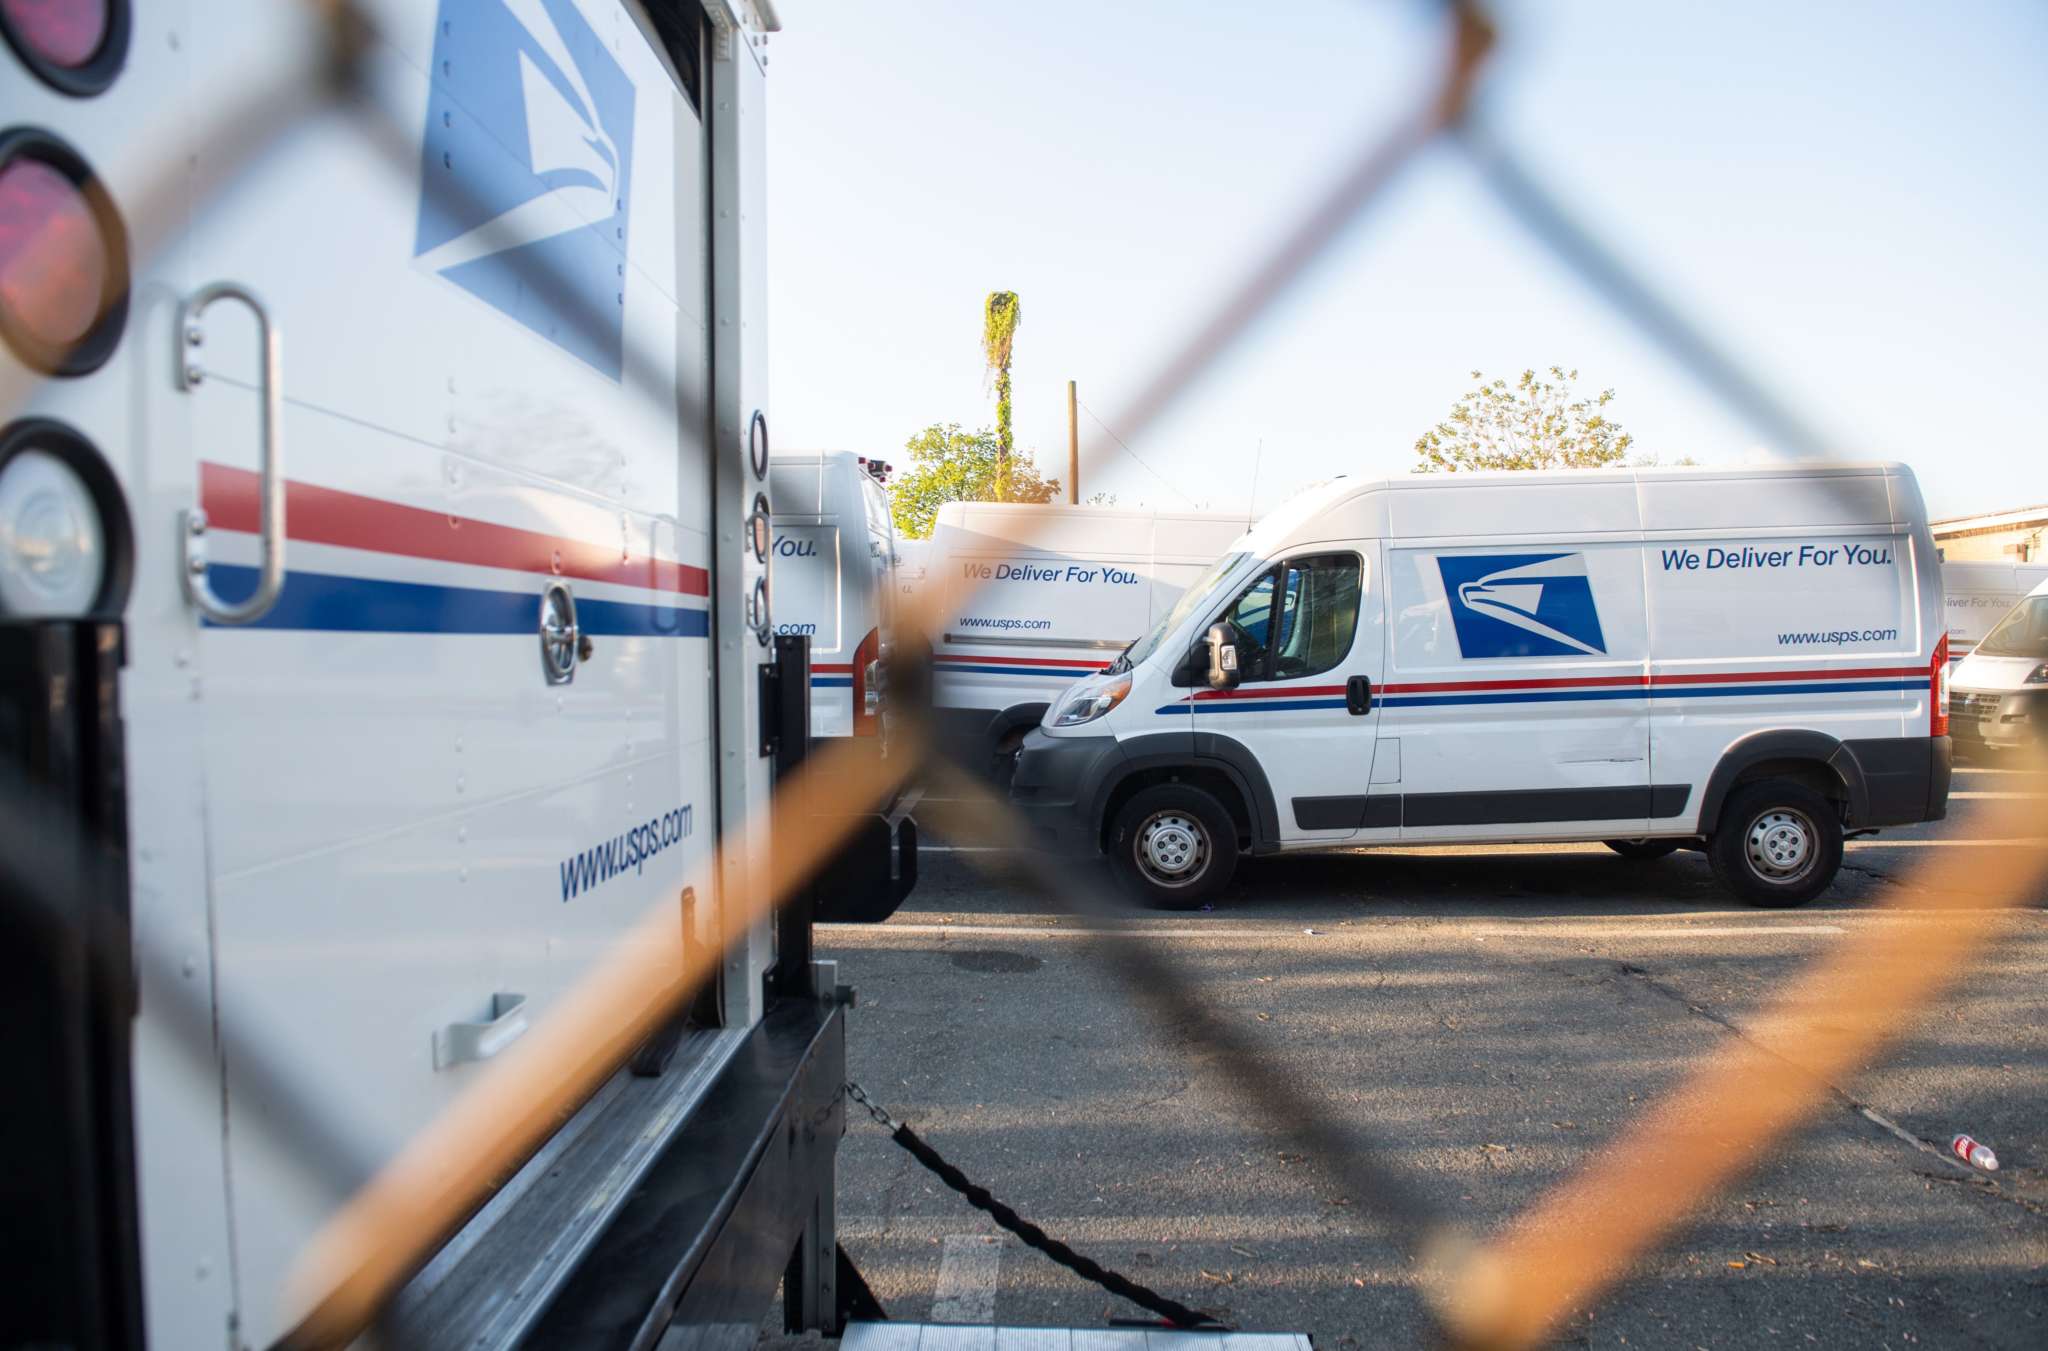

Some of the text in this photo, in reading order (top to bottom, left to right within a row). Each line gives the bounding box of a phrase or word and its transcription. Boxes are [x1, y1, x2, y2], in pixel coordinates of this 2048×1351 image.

[1661, 544, 1893, 571] We Deliver For You.
[964, 563, 1139, 585] We Deliver For You.
[1970, 598, 1989, 608] For
[959, 616, 1051, 631] www.usps.com
[1777, 628, 1898, 646] www.usps.com
[560, 803, 692, 904] www.usps.com
